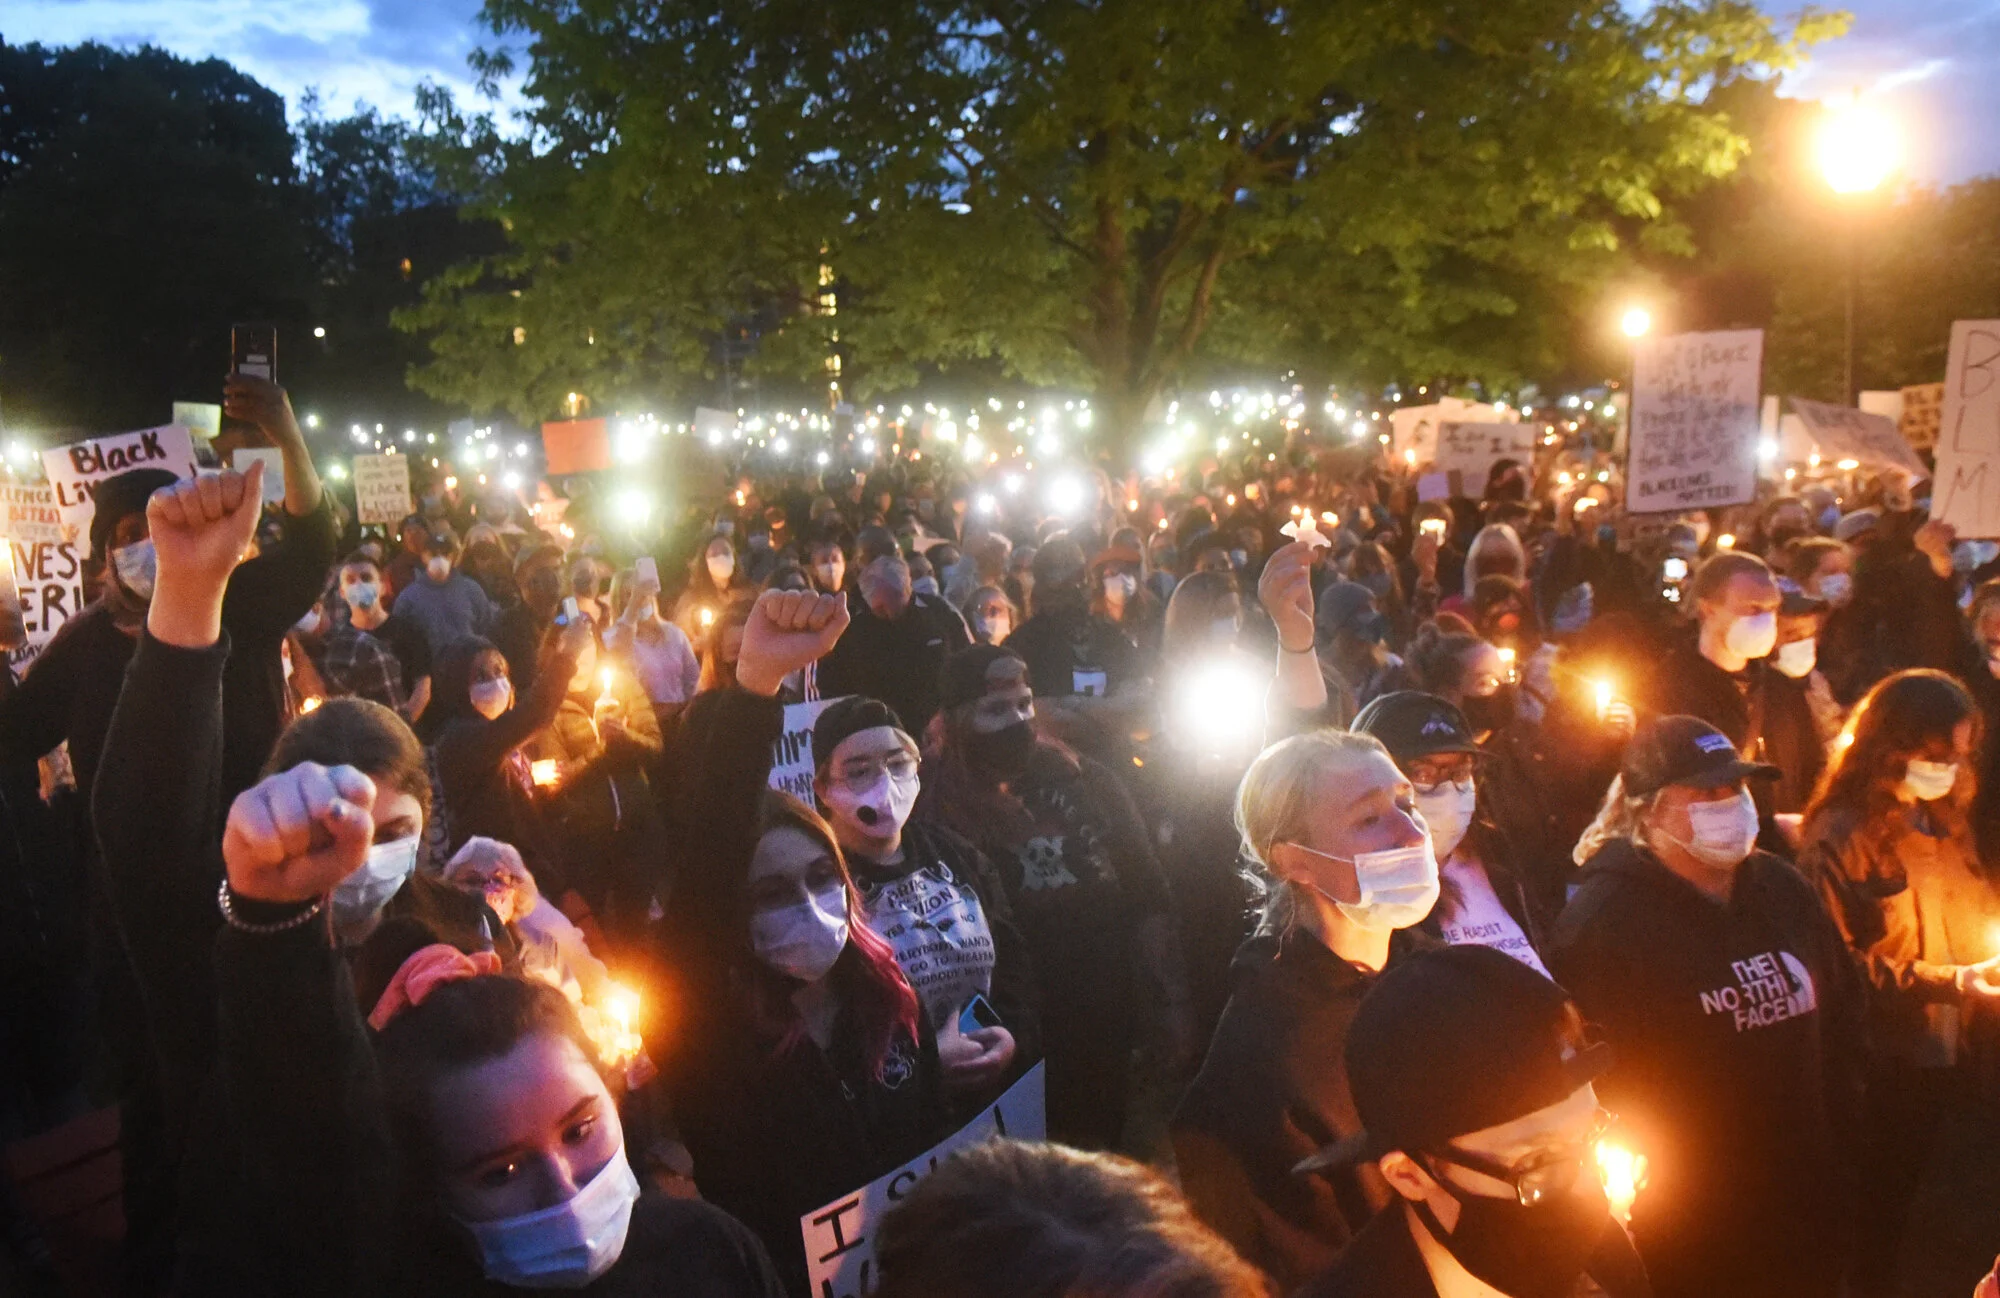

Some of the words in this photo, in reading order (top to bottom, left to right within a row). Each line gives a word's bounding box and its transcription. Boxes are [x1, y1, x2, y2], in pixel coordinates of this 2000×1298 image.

[69, 431, 167, 475] Black
[910, 961, 929, 974] GO
[934, 954, 949, 967] TO
[1731, 955, 1776, 983] THE
[1734, 998, 1789, 1033] FACE
